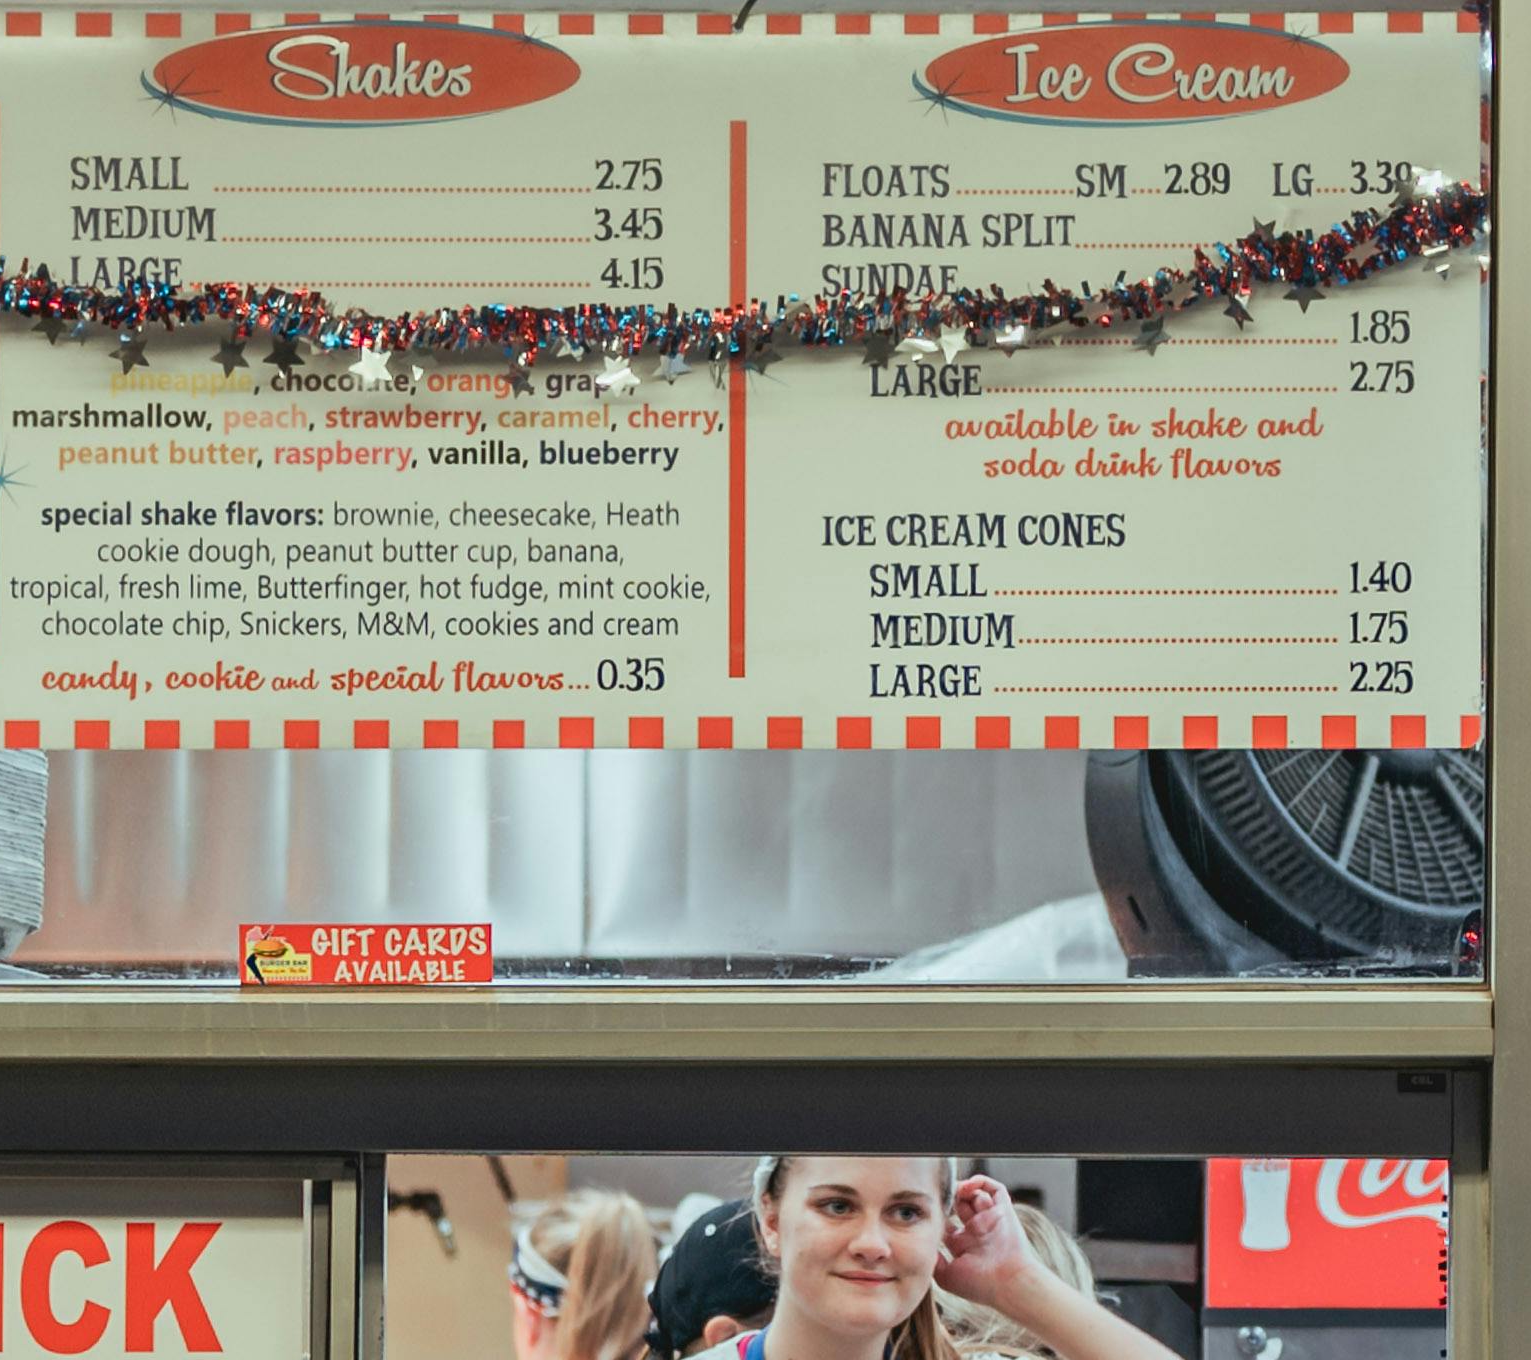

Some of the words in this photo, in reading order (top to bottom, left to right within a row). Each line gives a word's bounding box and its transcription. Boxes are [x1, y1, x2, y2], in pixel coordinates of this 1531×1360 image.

[266, 34, 473, 101] Shakes
[1002, 42, 1093, 103] Ice
[1105, 42, 1298, 106] Cream
[70, 155, 189, 192] SMALL
[595, 158, 663, 192] 2.75
[822, 162, 950, 199] FLOATS
[1075, 163, 1128, 199] SM
[1164, 161, 1231, 196] 2.89
[1272, 162, 1315, 198] LG
[70, 205, 217, 242] MEDIUM
[594, 207, 664, 242] 3.45
[822, 212, 969, 249] BANANA
[981, 212, 1076, 248] SPLIT
[12, 403, 212, 432] marshmallow,
[223, 406, 316, 432] peach,
[325, 403, 487, 436] strawberry,
[498, 403, 617, 433] caramel,
[627, 403, 724, 435] cherry,
[58, 442, 159, 472] peanut
[170, 444, 263, 469] butter,
[275, 441, 418, 472] raspberry,
[427, 439, 529, 469] vanilla,
[539, 439, 680, 472] blueberry
[41, 500, 132, 533] special
[141, 500, 217, 526] shake
[225, 500, 324, 527] flavors:
[334, 500, 439, 529] brownie,
[449, 500, 596, 529] cheesecake,
[606, 501, 680, 527] Heath
[821, 515, 877, 547] ICE
[886, 512, 1007, 549] CREAM
[1017, 512, 1126, 549] CONES
[869, 562, 988, 599] SMALL
[1350, 560, 1412, 594] 1.40
[870, 612, 1016, 649] MEDIUM
[1350, 610, 1409, 645] 1.75
[869, 663, 982, 699] LARGE
[1349, 660, 1414, 695] 2.25
[311, 927, 375, 956] GIFT
[384, 926, 488, 956] CARDS
[334, 959, 466, 983] AVAILABLE
